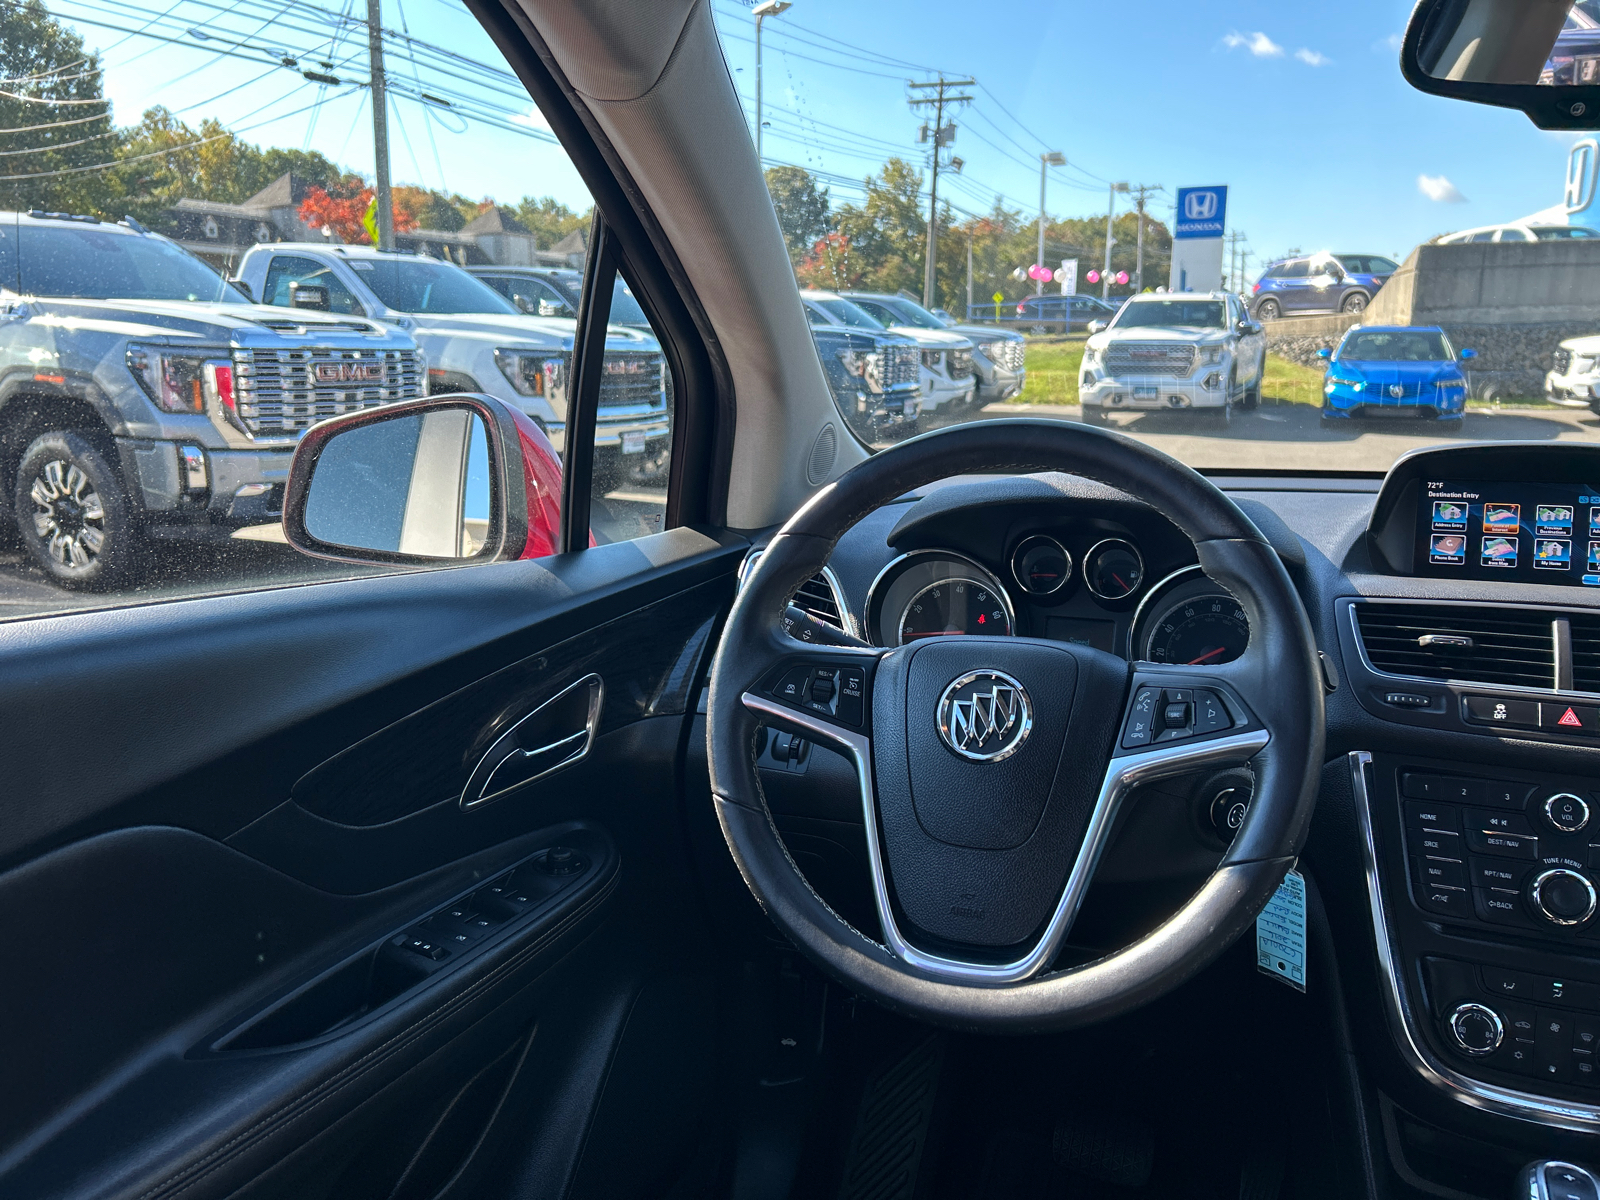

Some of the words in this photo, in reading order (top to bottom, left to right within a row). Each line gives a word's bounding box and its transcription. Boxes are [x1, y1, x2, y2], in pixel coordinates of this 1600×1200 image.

[1177, 222, 1223, 232] HONDA
[316, 363, 384, 381] GMC
[932, 590, 941, 598] 30
[977, 592, 986, 602] 50
[1185, 608, 1195, 617] 60
[1233, 609, 1246, 620] 100
[1164, 624, 1175, 634] 40
[1156, 648, 1164, 656] 20
[843, 688, 861, 697] CRUISE
[1564, 858, 1582, 869] MENU
[1288, 900, 1302, 908] COLOR
[1496, 901, 1513, 910] BACK
[1288, 919, 1302, 928] MODEL
